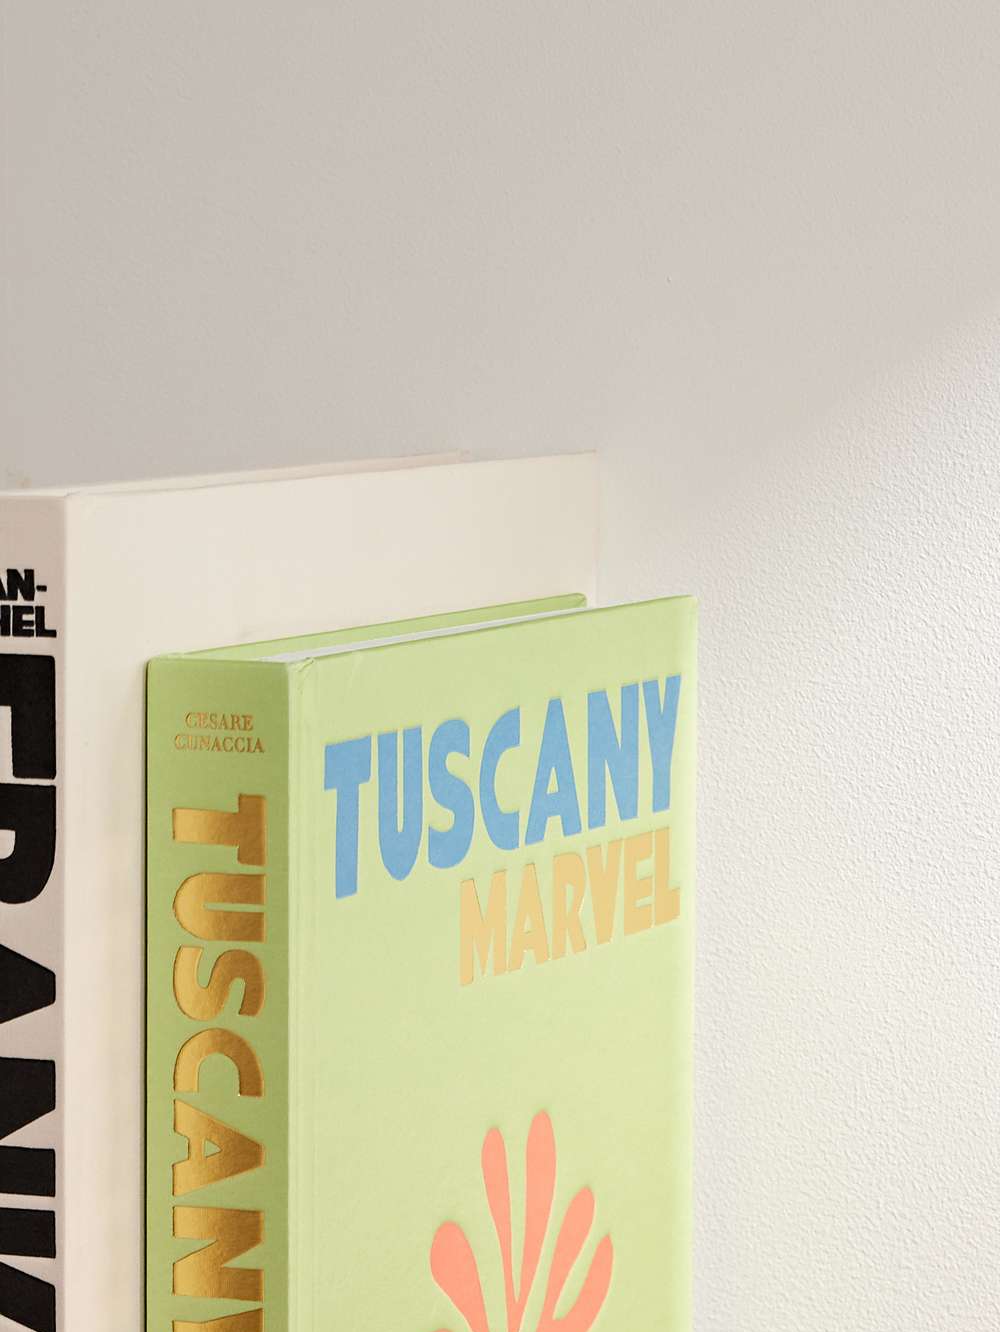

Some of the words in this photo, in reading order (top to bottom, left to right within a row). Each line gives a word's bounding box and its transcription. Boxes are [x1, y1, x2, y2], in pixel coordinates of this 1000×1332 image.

[0, 569, 47, 601] N-
[185, 712, 253, 731] CESARE
[174, 734, 265, 753] CUNACCIA
[323, 674, 682, 900] TUSCANY
[459, 826, 681, 987] MARVEL
